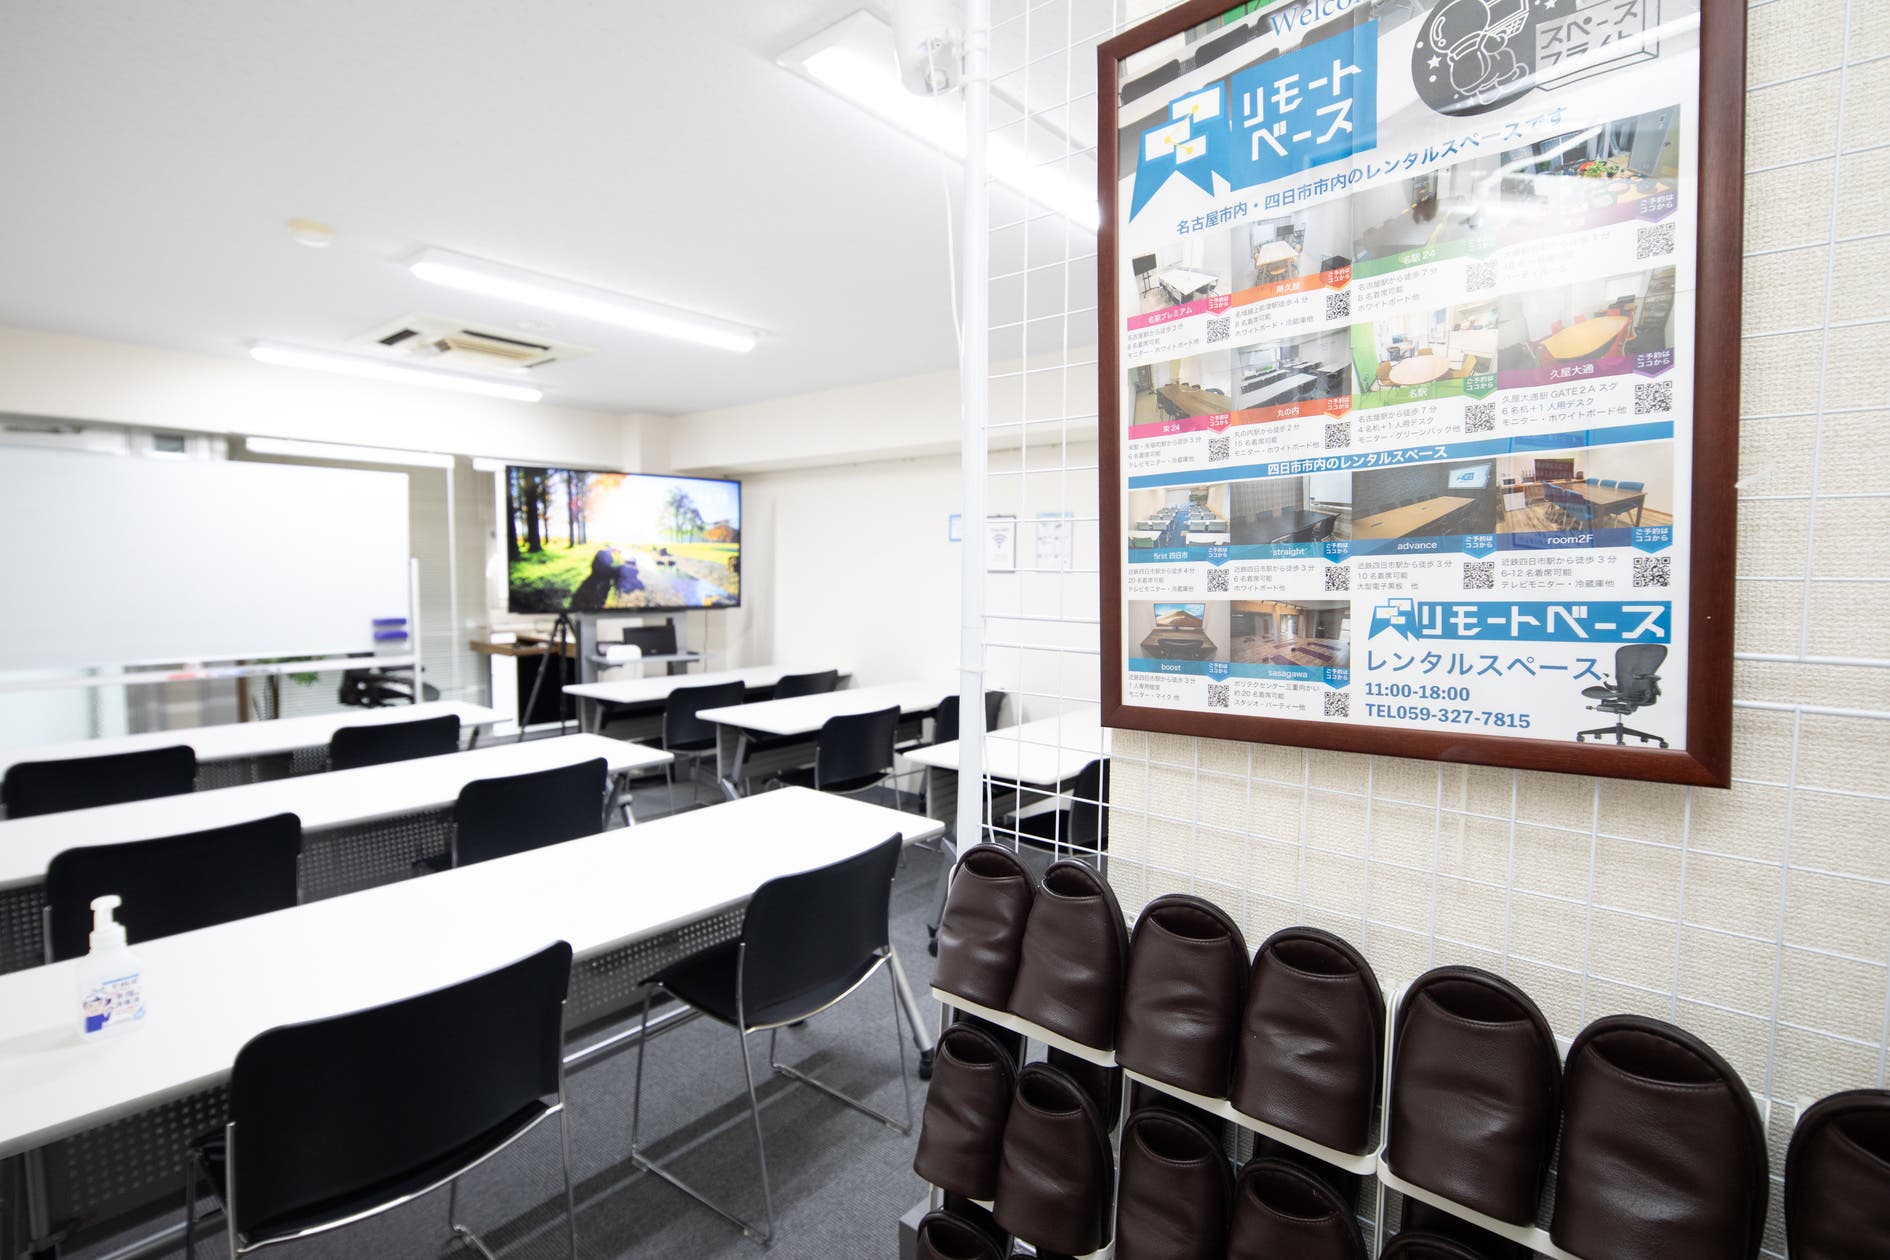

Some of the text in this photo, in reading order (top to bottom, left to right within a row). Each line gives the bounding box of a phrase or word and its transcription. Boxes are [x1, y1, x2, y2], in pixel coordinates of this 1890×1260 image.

[1269, 0, 1361, 36] Welco
[1541, 0, 1638, 49] スペース
[1243, 59, 1362, 128] リモート
[1251, 97, 1353, 161] ベース
[1176, 106, 1568, 235] 名古屋市内・四日市市内のレンタルスペースです
[1637, 350, 1670, 362] ご予約は
[1638, 358, 1671, 368] ココから
[1550, 363, 1594, 379] 久屋大通
[1277, 407, 1300, 418] 丸の内
[1267, 446, 1448, 475] 四日市市内のレンタルスペース
[1397, 541, 1438, 551] advance
[1547, 534, 1594, 545] room2F
[1272, 547, 1305, 557] straight
[1421, 605, 1665, 639] リモートベース
[1161, 663, 1181, 671] boost
[1268, 669, 1308, 679] sasagawa
[1366, 648, 1602, 681] レンタルスペース
[1365, 682, 1470, 701] 11:00-18:00
[1365, 703, 1531, 729] TEL059-327-7815
